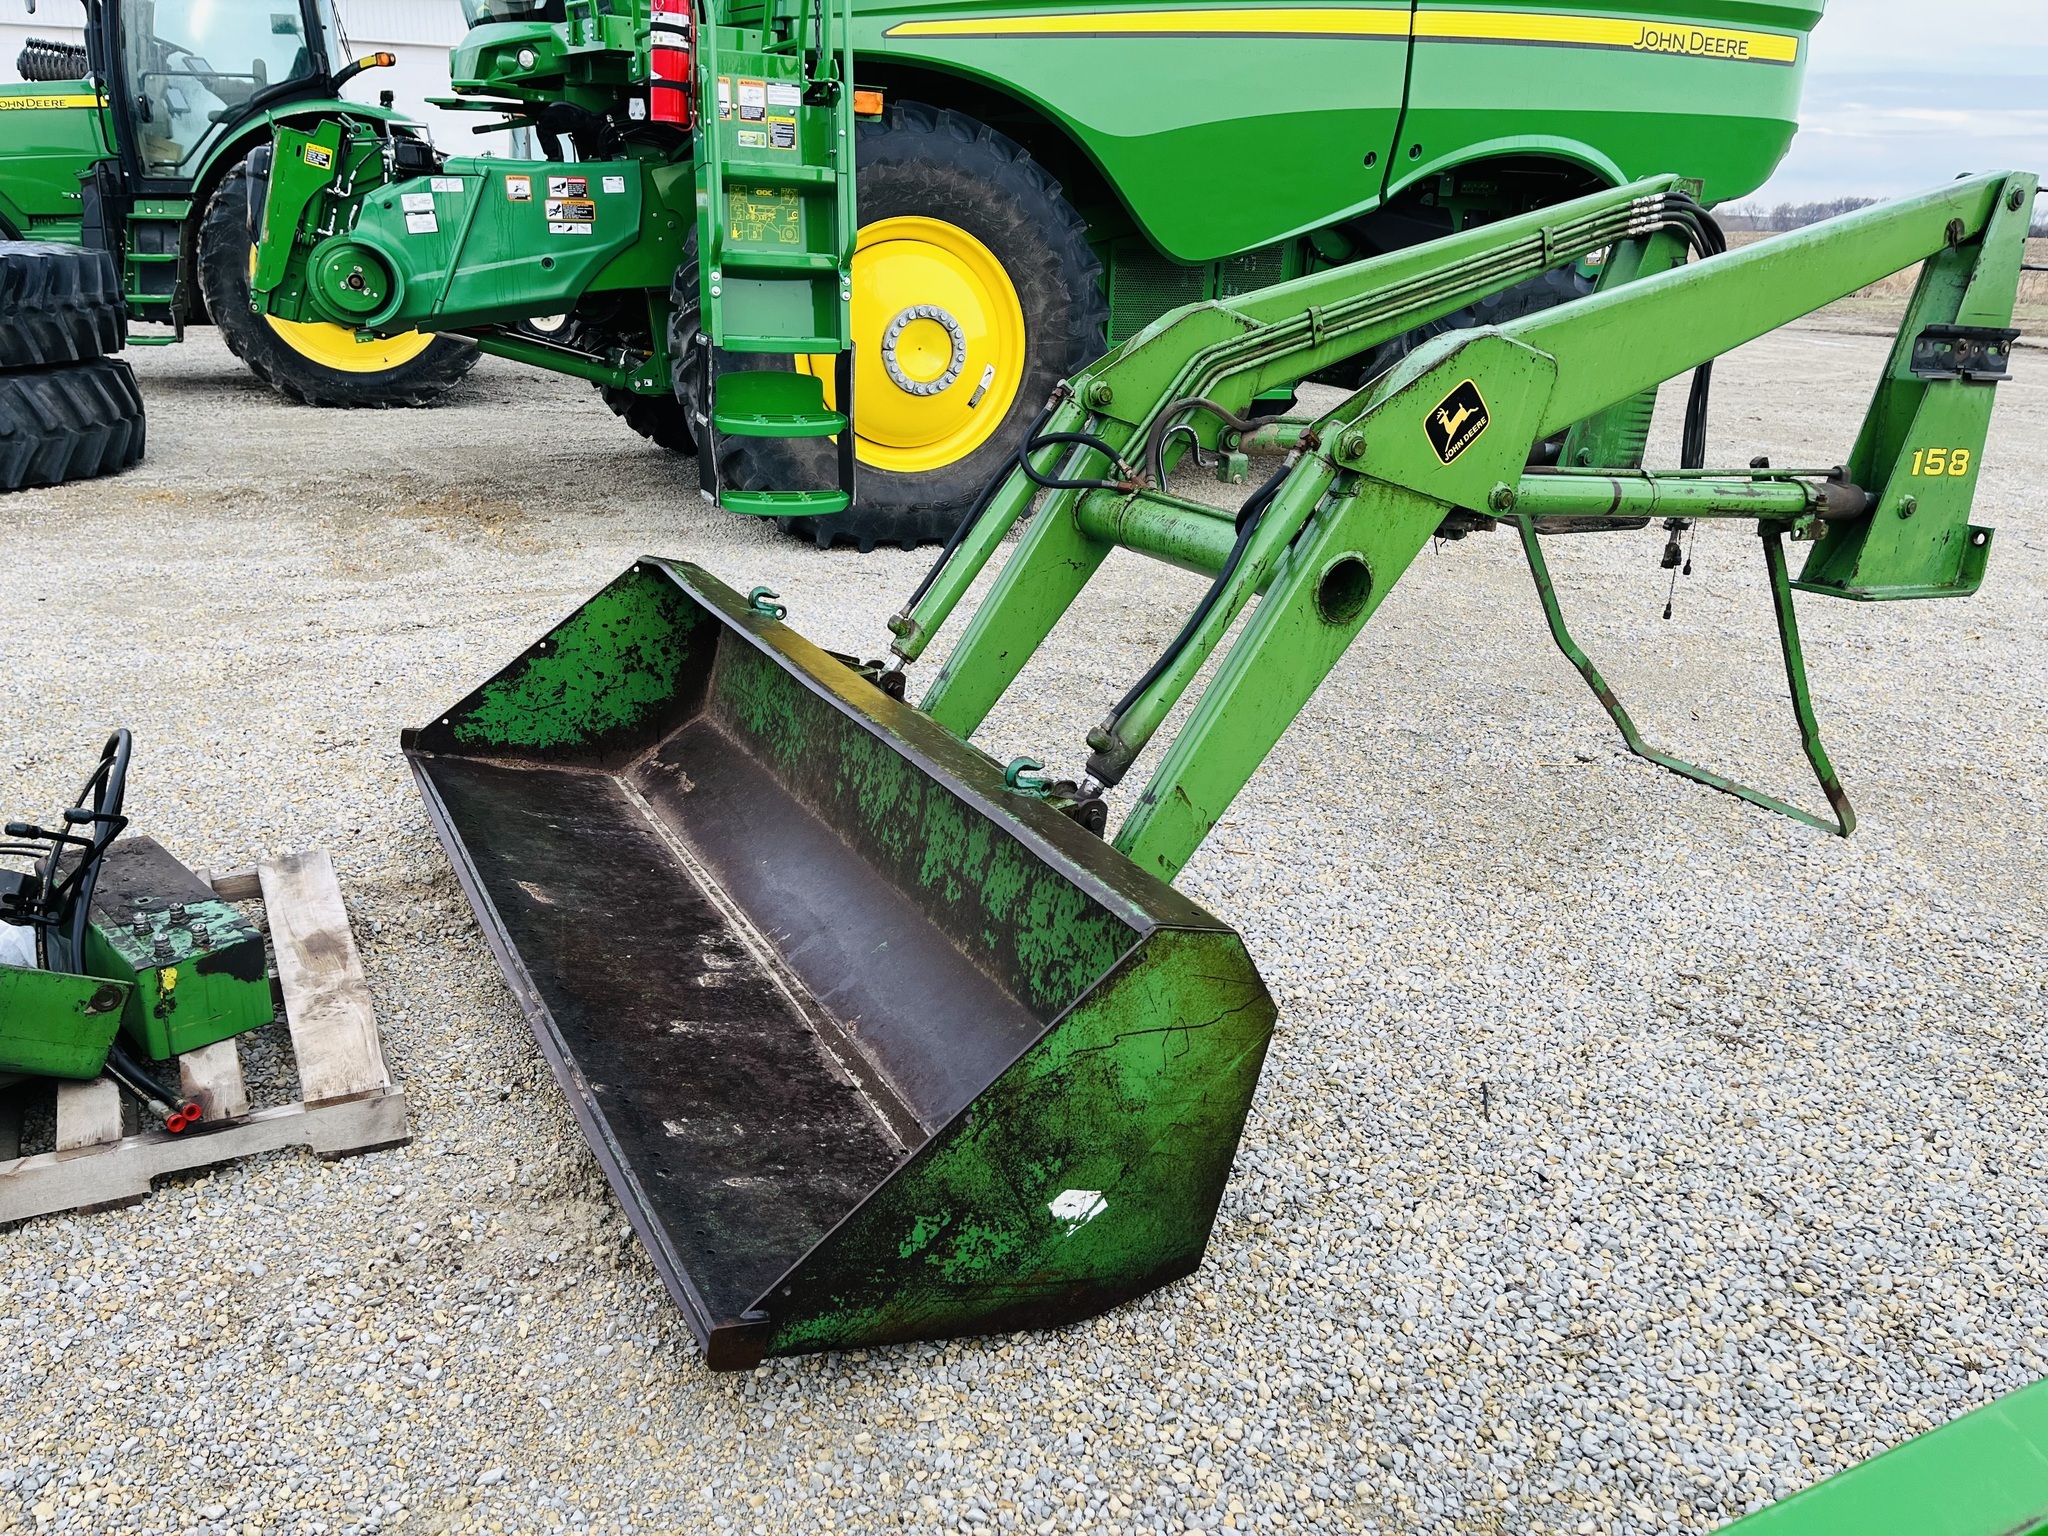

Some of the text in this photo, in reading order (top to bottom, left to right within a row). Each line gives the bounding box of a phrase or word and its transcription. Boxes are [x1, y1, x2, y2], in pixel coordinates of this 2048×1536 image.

[1634, 26, 1748, 56] JOHN DEERE
[0, 98, 67, 109] OHN DEERE
[1445, 416, 1487, 461] JOHN DEERE
[1911, 447, 1970, 476] 158
